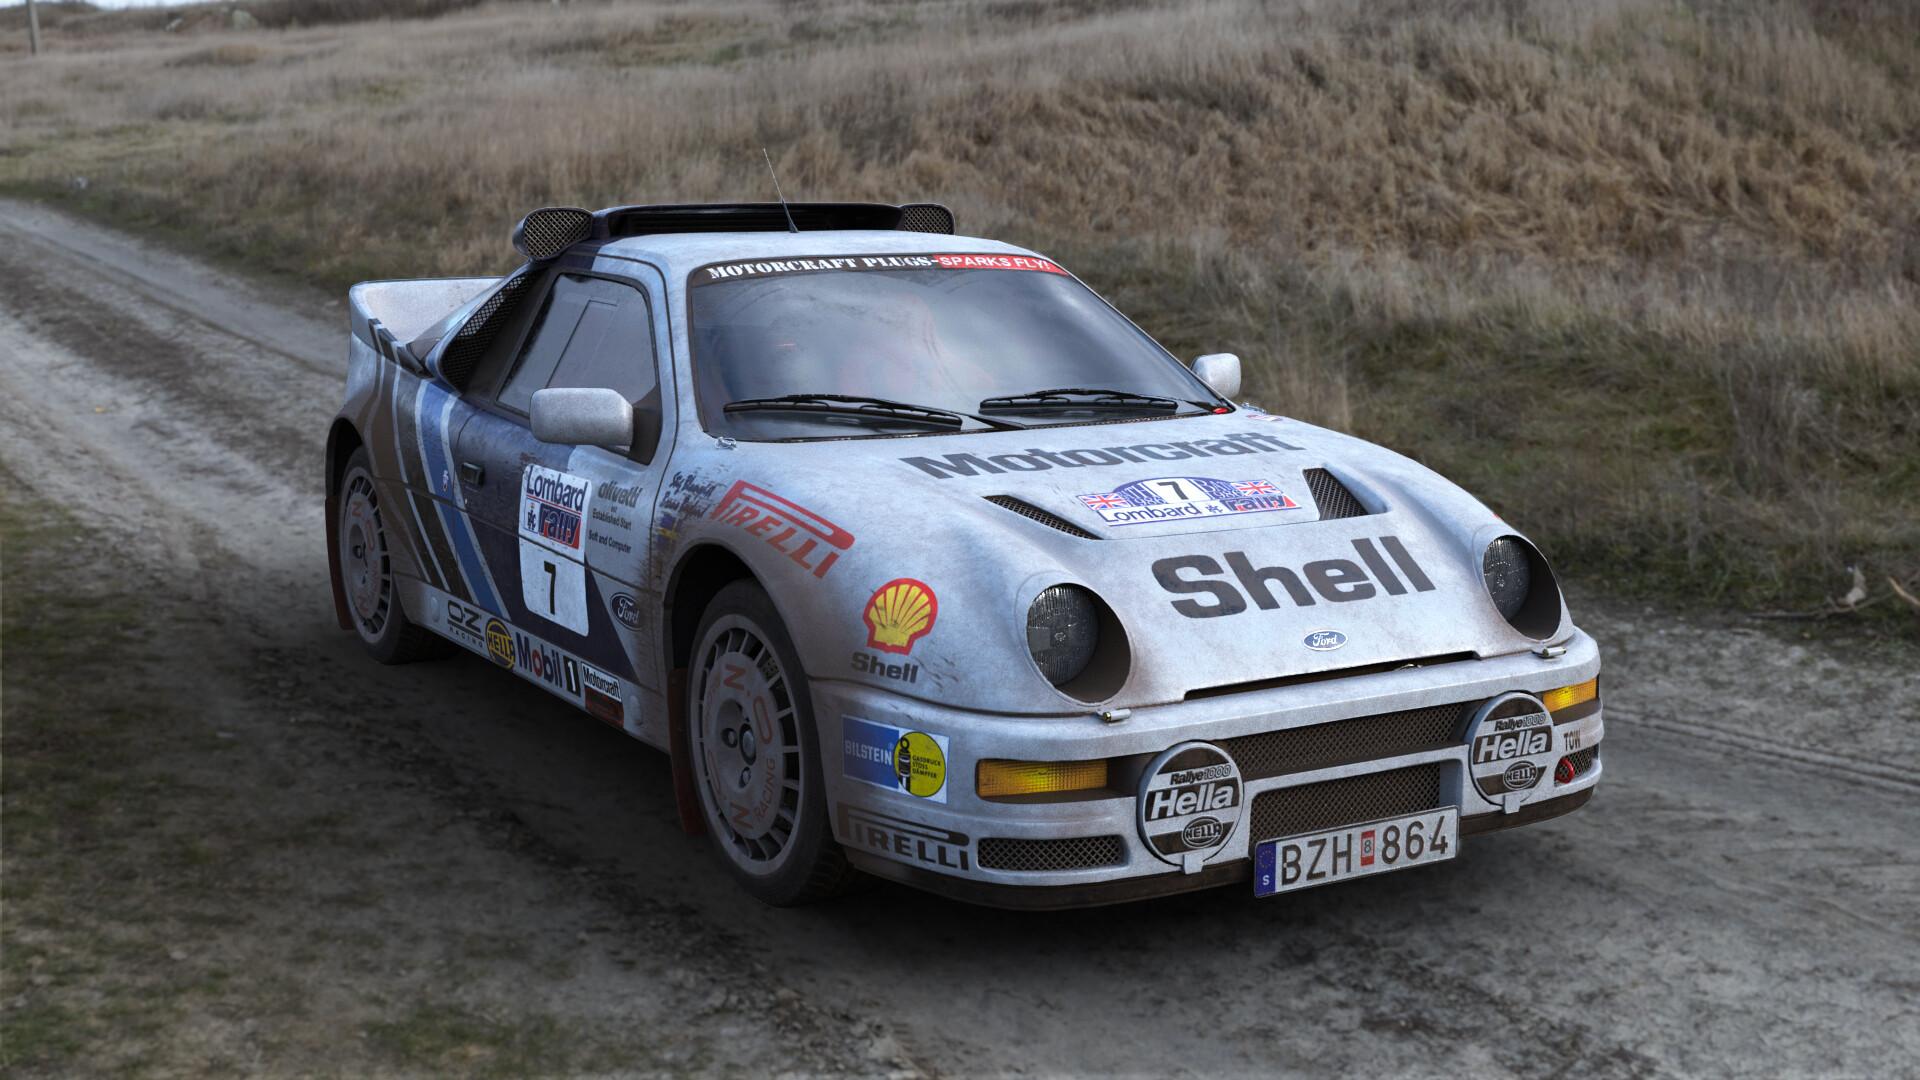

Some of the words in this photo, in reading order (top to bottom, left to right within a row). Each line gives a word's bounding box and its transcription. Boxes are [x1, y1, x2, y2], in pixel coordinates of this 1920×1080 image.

[707, 257, 857, 279] MOTORCRAFT
[1014, 257, 1051, 270] FLY!
[900, 431, 1306, 480] Motorcraft
[526, 465, 588, 512] Lombard
[1157, 481, 1189, 500] 7
[1096, 502, 1202, 522] Lombard
[709, 480, 855, 579] PIRELLI
[544, 560, 556, 615] 7
[1151, 535, 1437, 619] Shell
[617, 598, 640, 624] Ford
[1312, 632, 1337, 646] Ford
[516, 632, 562, 688] Mobil
[851, 652, 918, 684] Shell
[583, 666, 622, 699] Motorcraft
[844, 739, 893, 766] BILSTEIN
[1477, 730, 1547, 763] Hella
[1563, 730, 1582, 751] TOW
[1505, 766, 1537, 781] HELLA
[1151, 782, 1234, 819] Hella
[836, 802, 969, 871] PIRELLI
[1184, 821, 1222, 840] HELLA
[1281, 833, 1352, 886] BZH
[1381, 815, 1448, 865] 864
[1262, 874, 1270, 886] S
